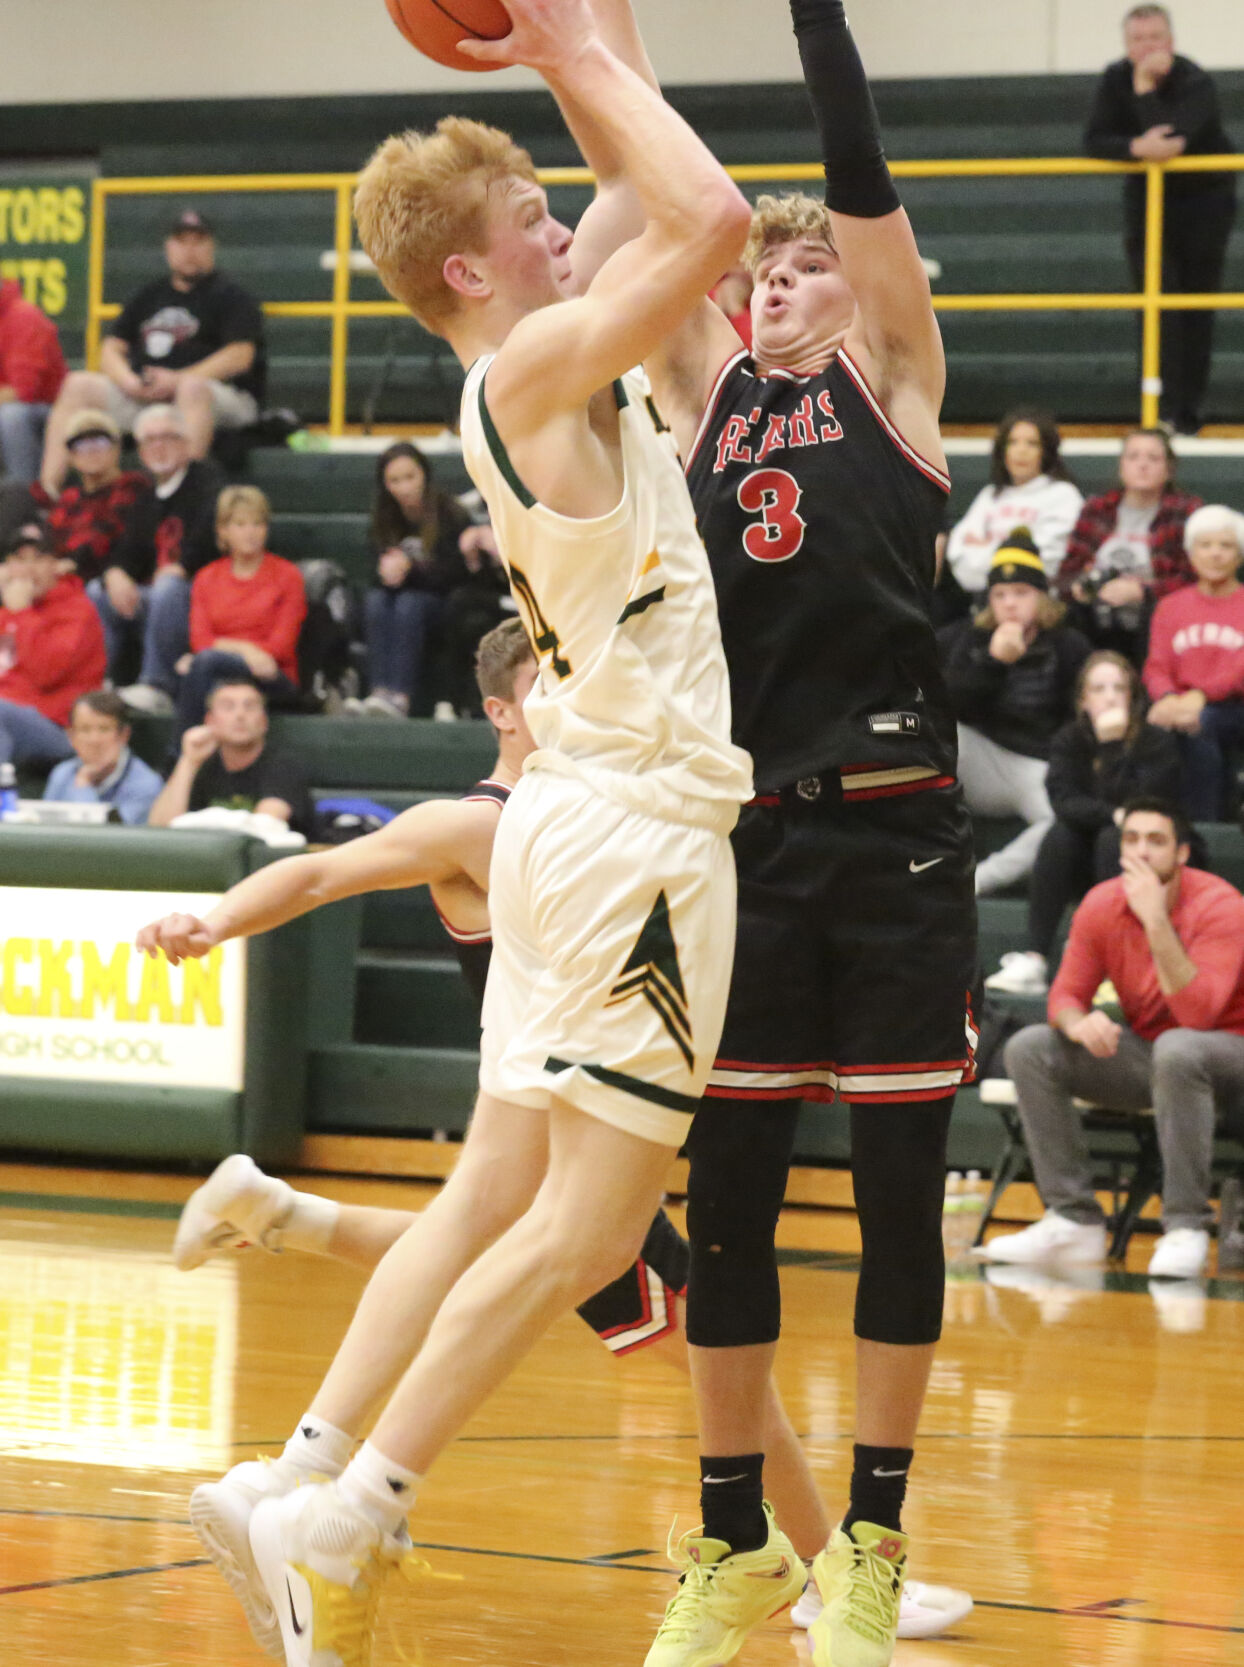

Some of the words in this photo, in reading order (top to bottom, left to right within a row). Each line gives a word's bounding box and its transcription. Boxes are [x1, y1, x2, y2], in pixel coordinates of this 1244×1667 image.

[737, 467, 808, 563] 3
[906, 718, 915, 728] M
[51, 1033, 173, 1067] SCHOOL
